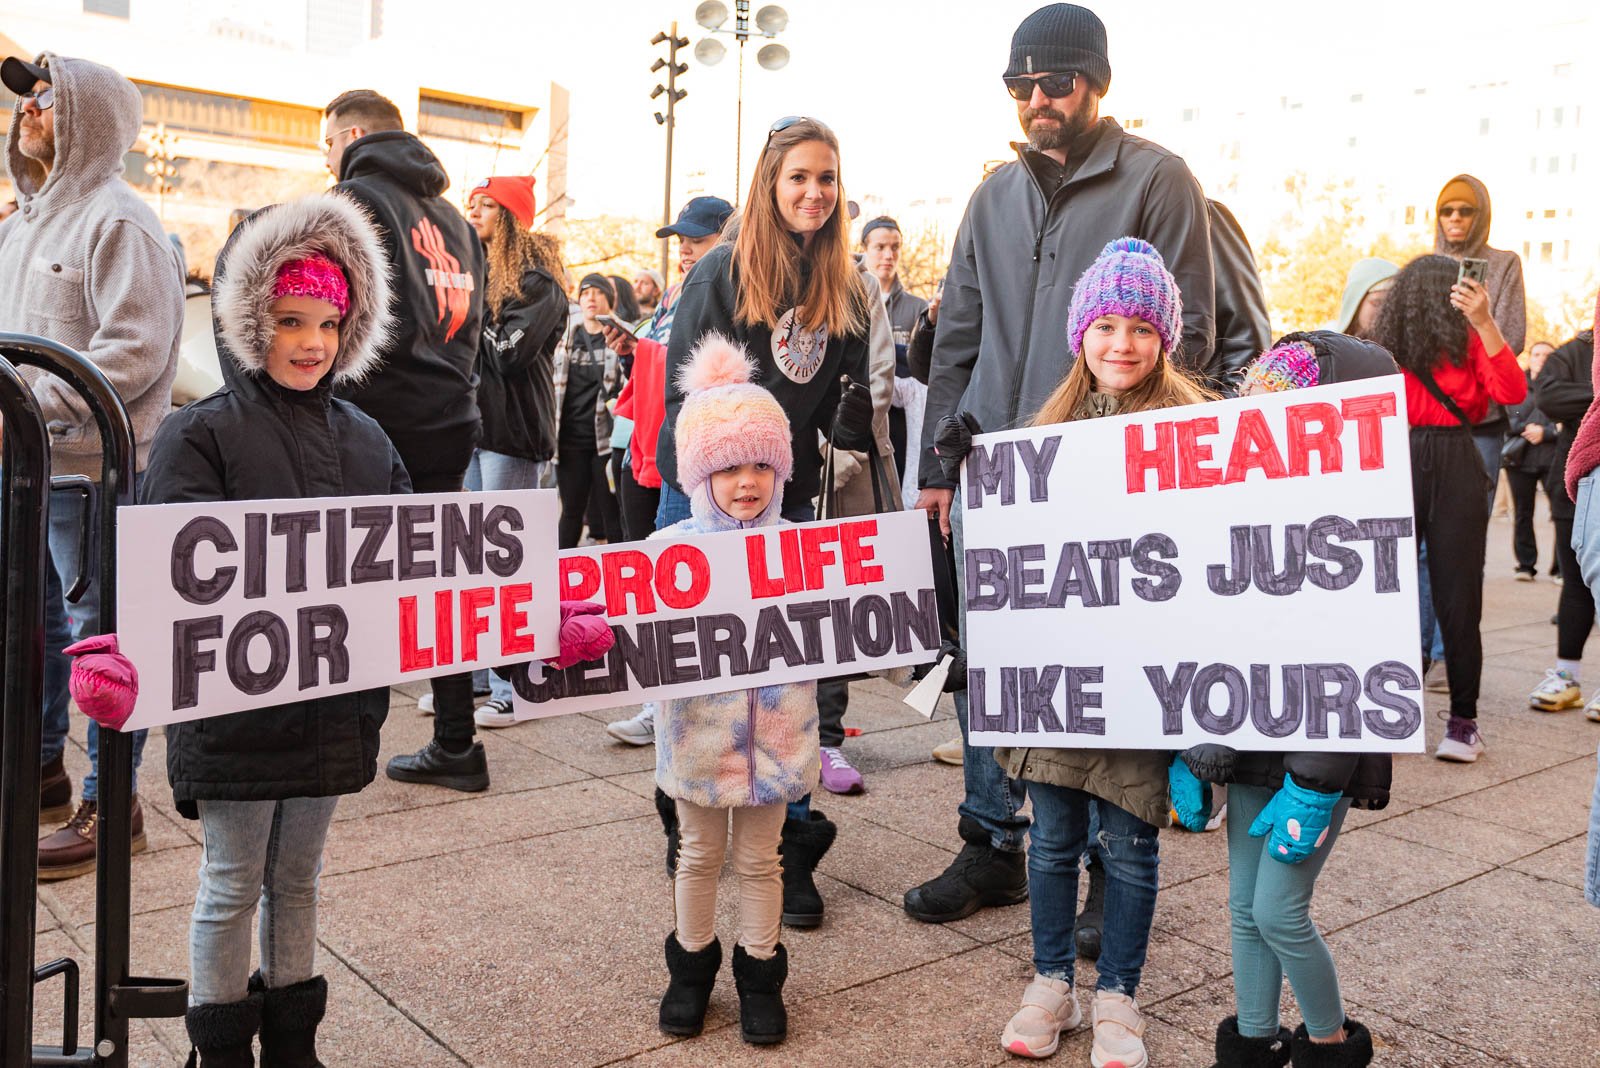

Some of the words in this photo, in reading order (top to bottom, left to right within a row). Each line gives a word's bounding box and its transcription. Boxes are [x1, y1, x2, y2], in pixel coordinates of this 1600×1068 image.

[966, 435, 1062, 510] MY
[1125, 391, 1396, 494] HEART
[171, 502, 524, 605] CITIZENS
[559, 544, 711, 617] PRO
[745, 519, 885, 600] LIFE
[965, 532, 1182, 612] BEATS
[1206, 515, 1413, 597] JUST
[173, 604, 350, 711] FOR
[399, 582, 535, 674] LIFE
[969, 665, 1106, 736] LIKE
[1143, 660, 1422, 740] YOURS
